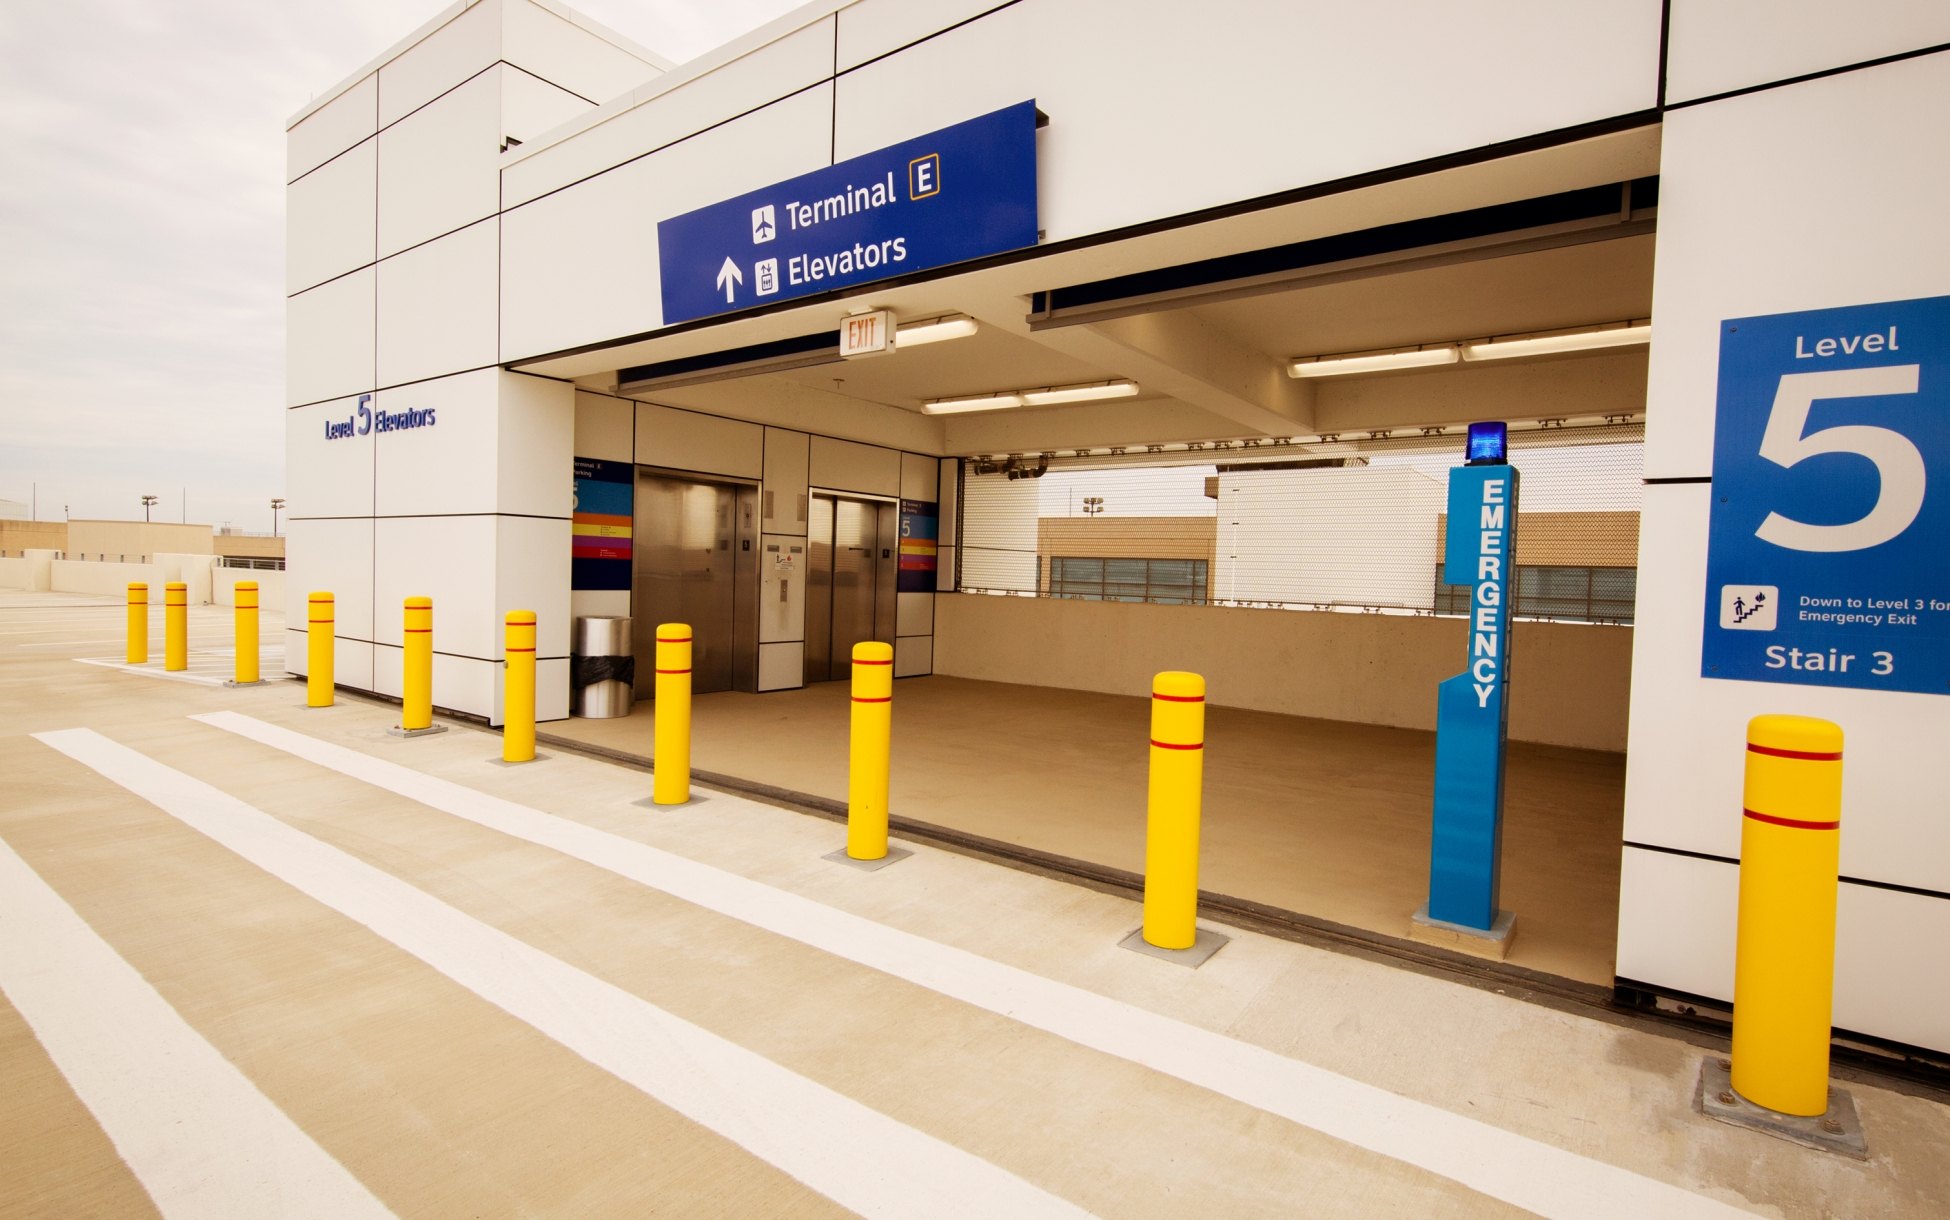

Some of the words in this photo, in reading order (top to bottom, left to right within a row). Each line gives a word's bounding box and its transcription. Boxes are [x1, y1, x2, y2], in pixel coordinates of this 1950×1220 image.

[786, 171, 896, 230] Terminal
[917, 162, 932, 193] E
[789, 236, 906, 285] Elevators
[848, 317, 876, 350] EXIT
[1795, 325, 1899, 359] Level
[325, 415, 355, 440] Level
[357, 394, 371, 436] 5
[374, 407, 436, 433] Elevators
[573, 470, 592, 478] arking
[1754, 363, 1927, 553] 5
[902, 520, 911, 537] 5
[1473, 479, 1504, 708] EMERGENCY
[1800, 596, 1842, 607] Down
[1847, 597, 1862, 608] to
[1867, 598, 1909, 610] Level
[1914, 599, 1924, 610] 3
[1799, 610, 1882, 627] Emergency
[1887, 613, 1917, 625] Exit
[1765, 645, 1855, 673] Stair
[1870, 651, 1894, 675] 3
